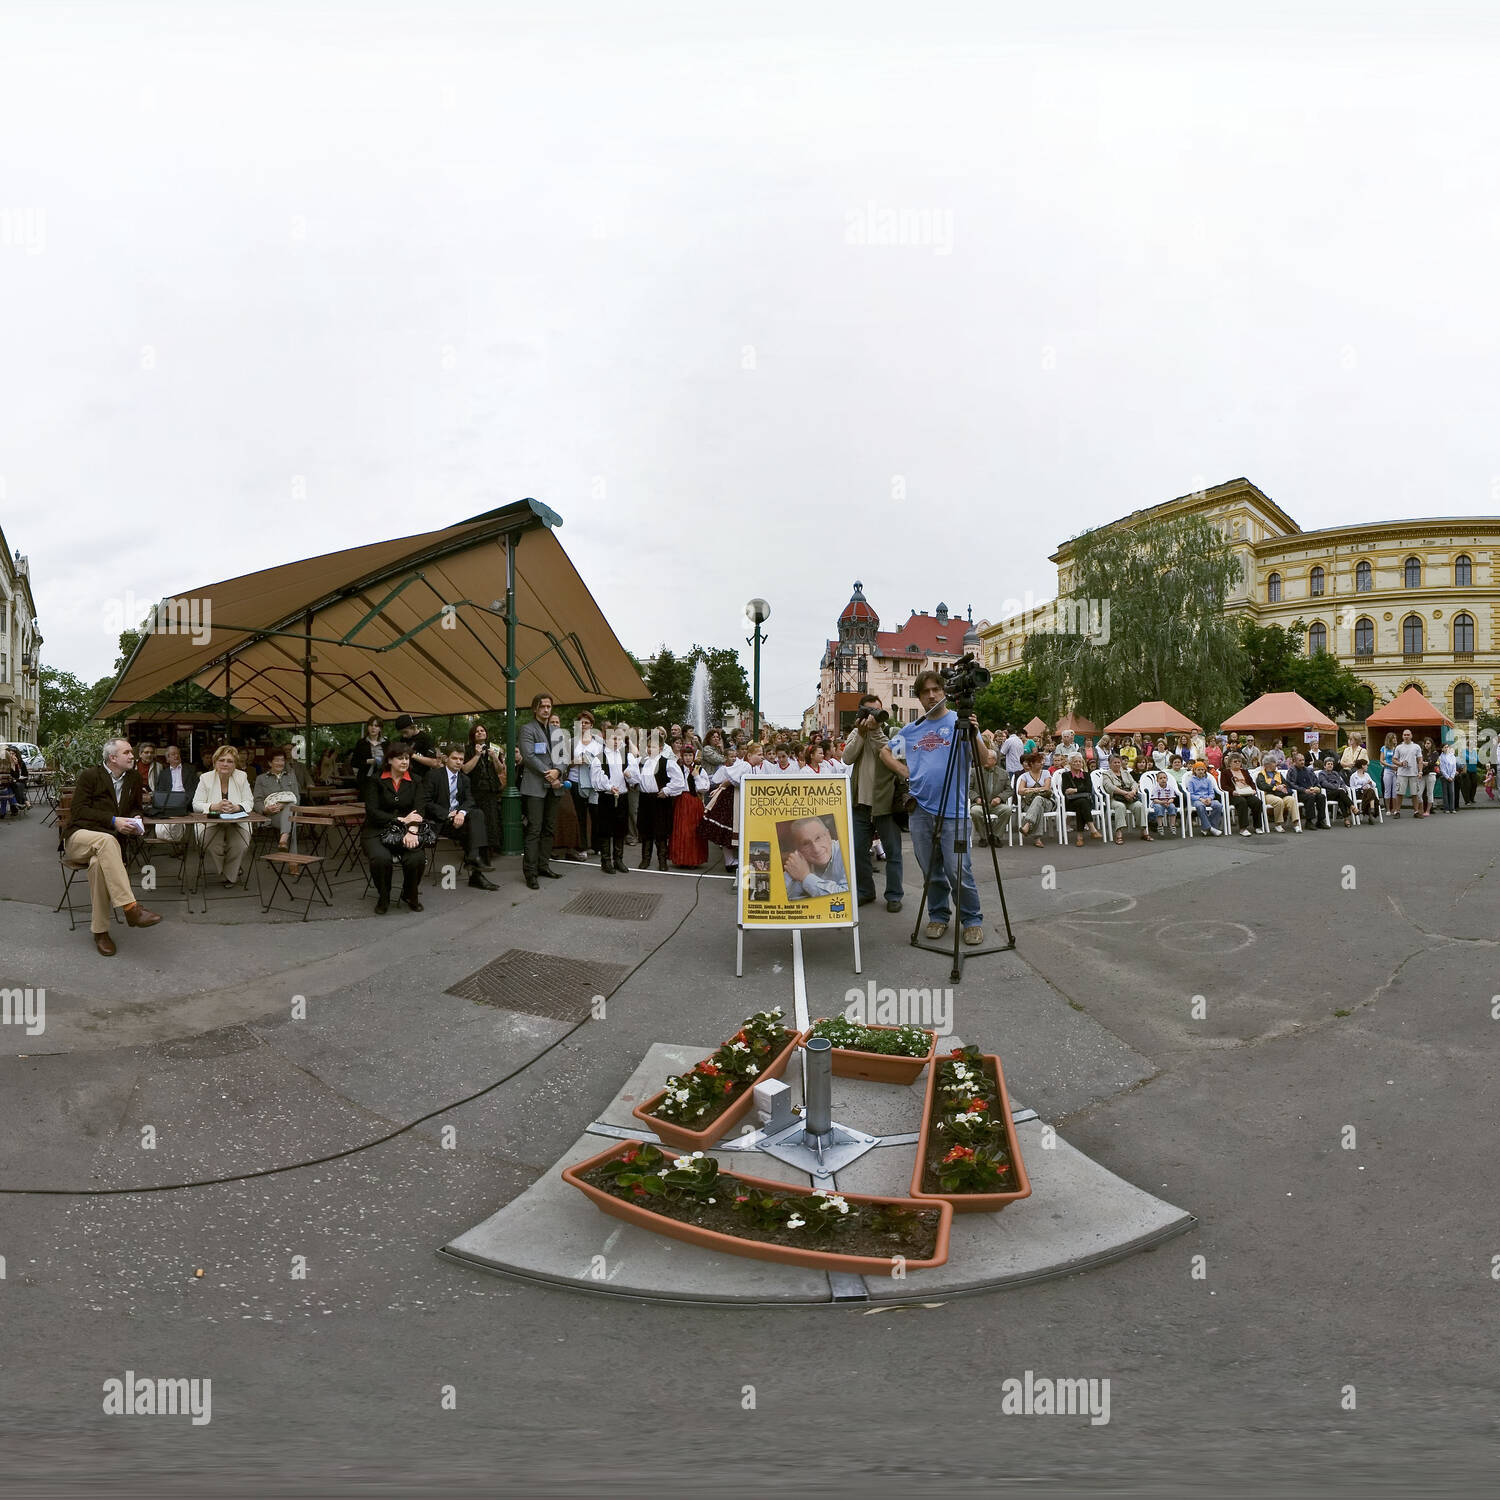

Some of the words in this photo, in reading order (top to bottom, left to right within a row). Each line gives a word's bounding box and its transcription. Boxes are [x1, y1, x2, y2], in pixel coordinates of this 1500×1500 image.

[750, 783, 800, 796] UNGVÁRI
[803, 783, 842, 796] TAMÁS
[750, 795, 790, 806] DEDIKÁL
[792, 797, 804, 806] AZ
